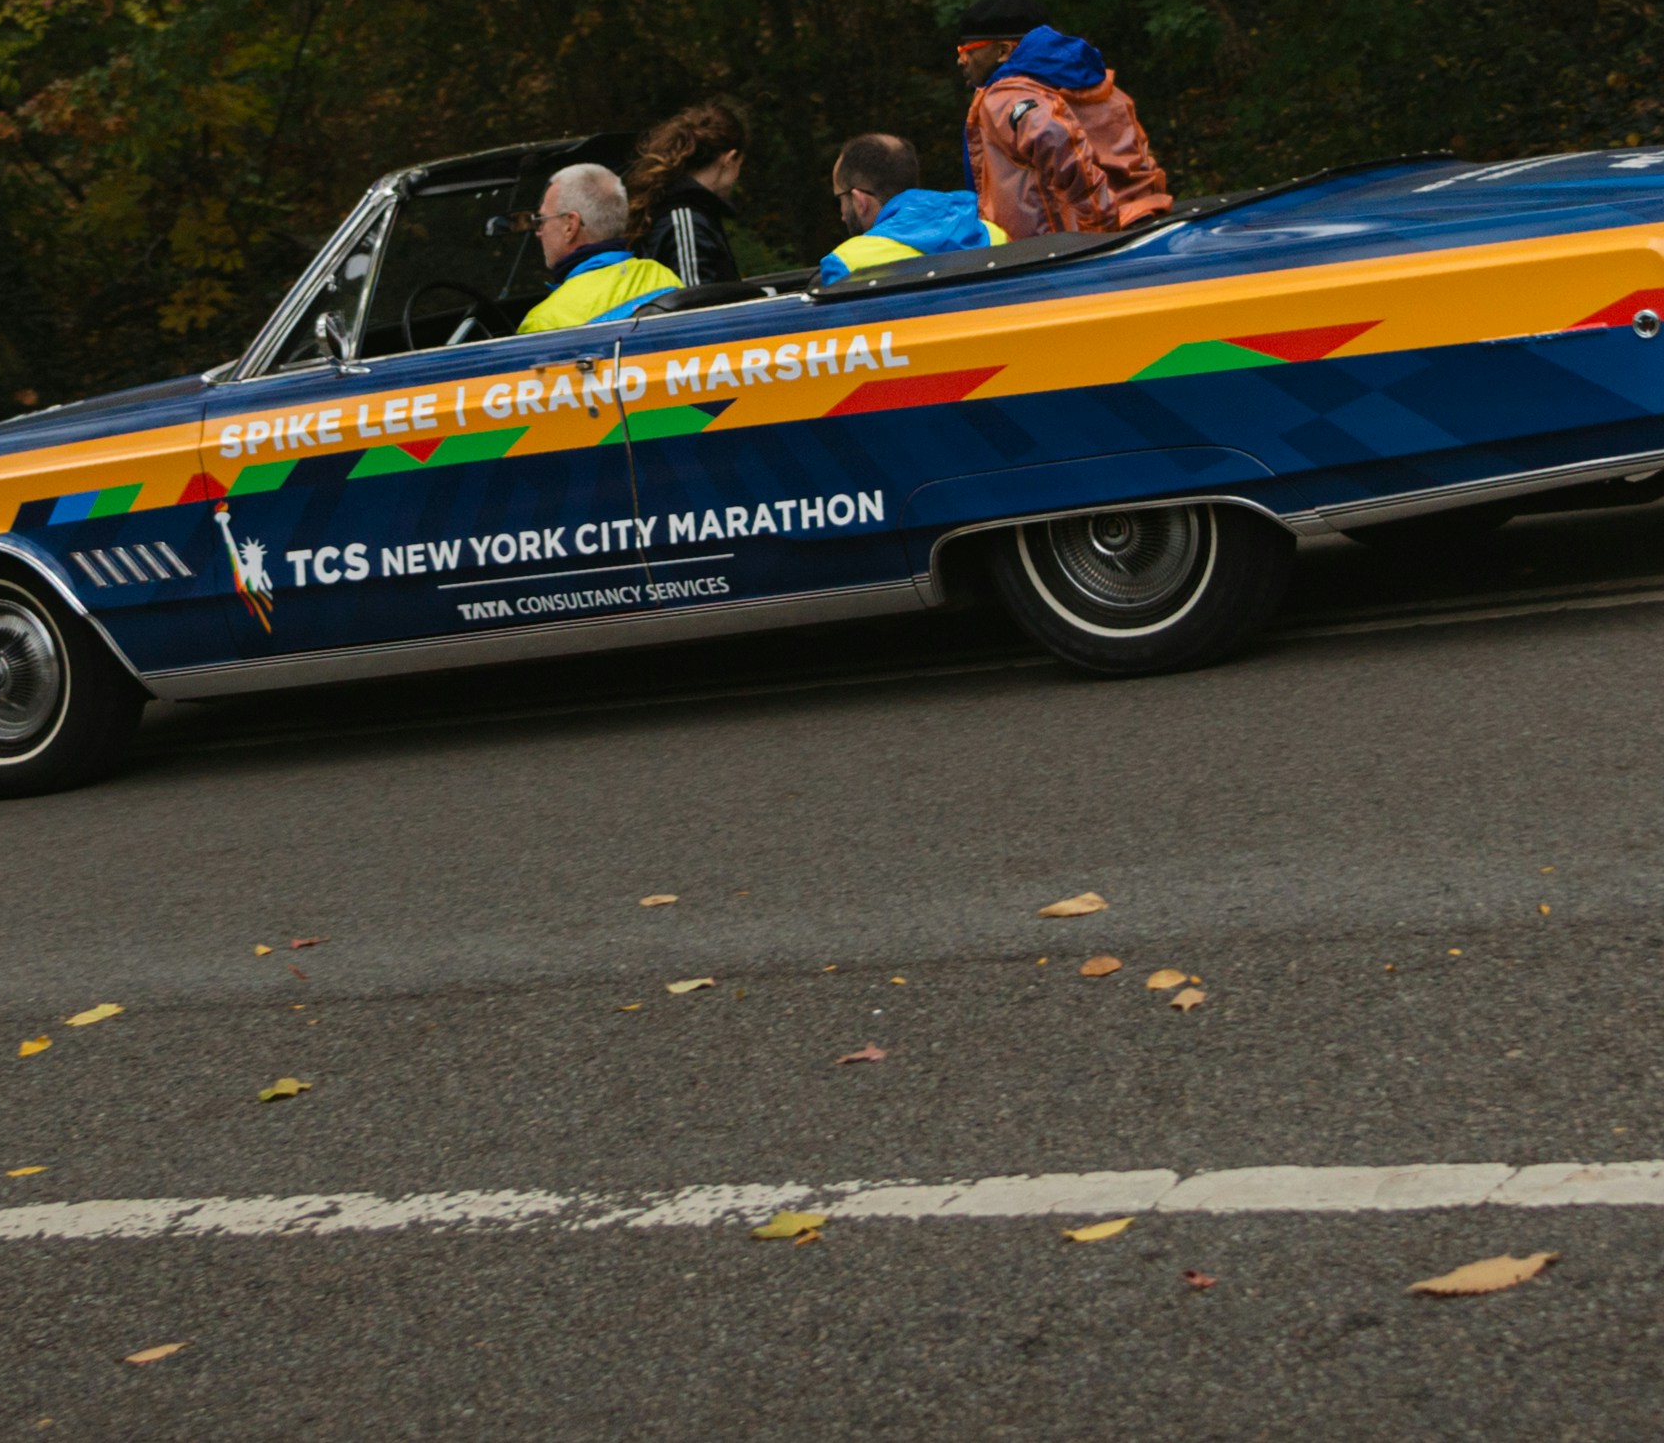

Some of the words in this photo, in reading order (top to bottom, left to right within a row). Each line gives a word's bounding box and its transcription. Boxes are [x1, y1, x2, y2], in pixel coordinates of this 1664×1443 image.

[220, 409, 343, 458] SPIKE
[357, 393, 438, 438] LEE
[483, 365, 646, 419] GRAND
[665, 331, 910, 396] MARSHAL
[285, 542, 370, 587] TCS
[381, 538, 462, 577] NEW
[467, 526, 568, 566] YORK
[574, 515, 658, 555] CITY
[668, 489, 884, 544] MARATHON
[457, 602, 514, 620] TATA
[516, 585, 641, 615] CONSULTANCY
[645, 576, 730, 601] SERVICES
